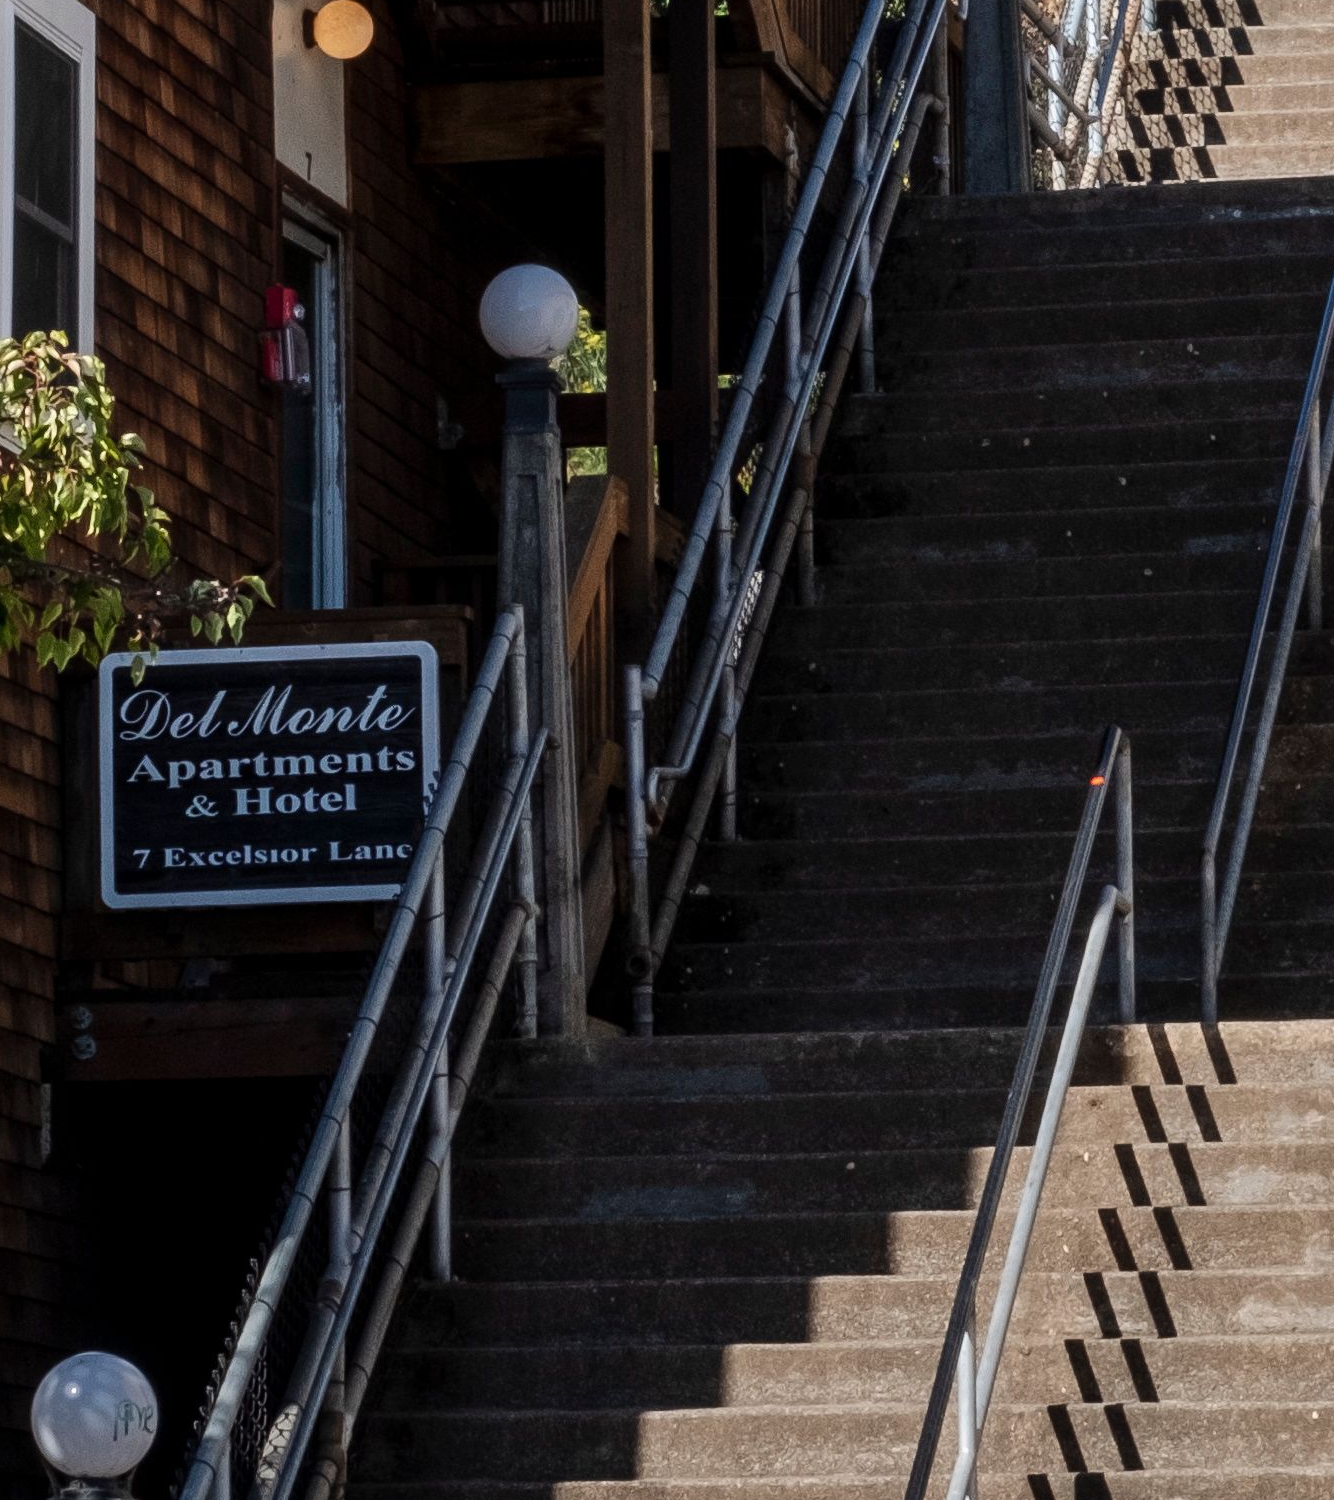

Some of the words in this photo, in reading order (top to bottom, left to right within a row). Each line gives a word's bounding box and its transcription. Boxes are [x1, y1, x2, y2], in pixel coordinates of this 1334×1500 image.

[120, 690, 227, 741] Del
[228, 685, 416, 736] Monte
[127, 746, 416, 789] Apartments
[185, 794, 219, 818] &
[232, 783, 357, 816] Hotel
[133, 849, 151, 870] 7
[164, 844, 317, 868] Excelsior
